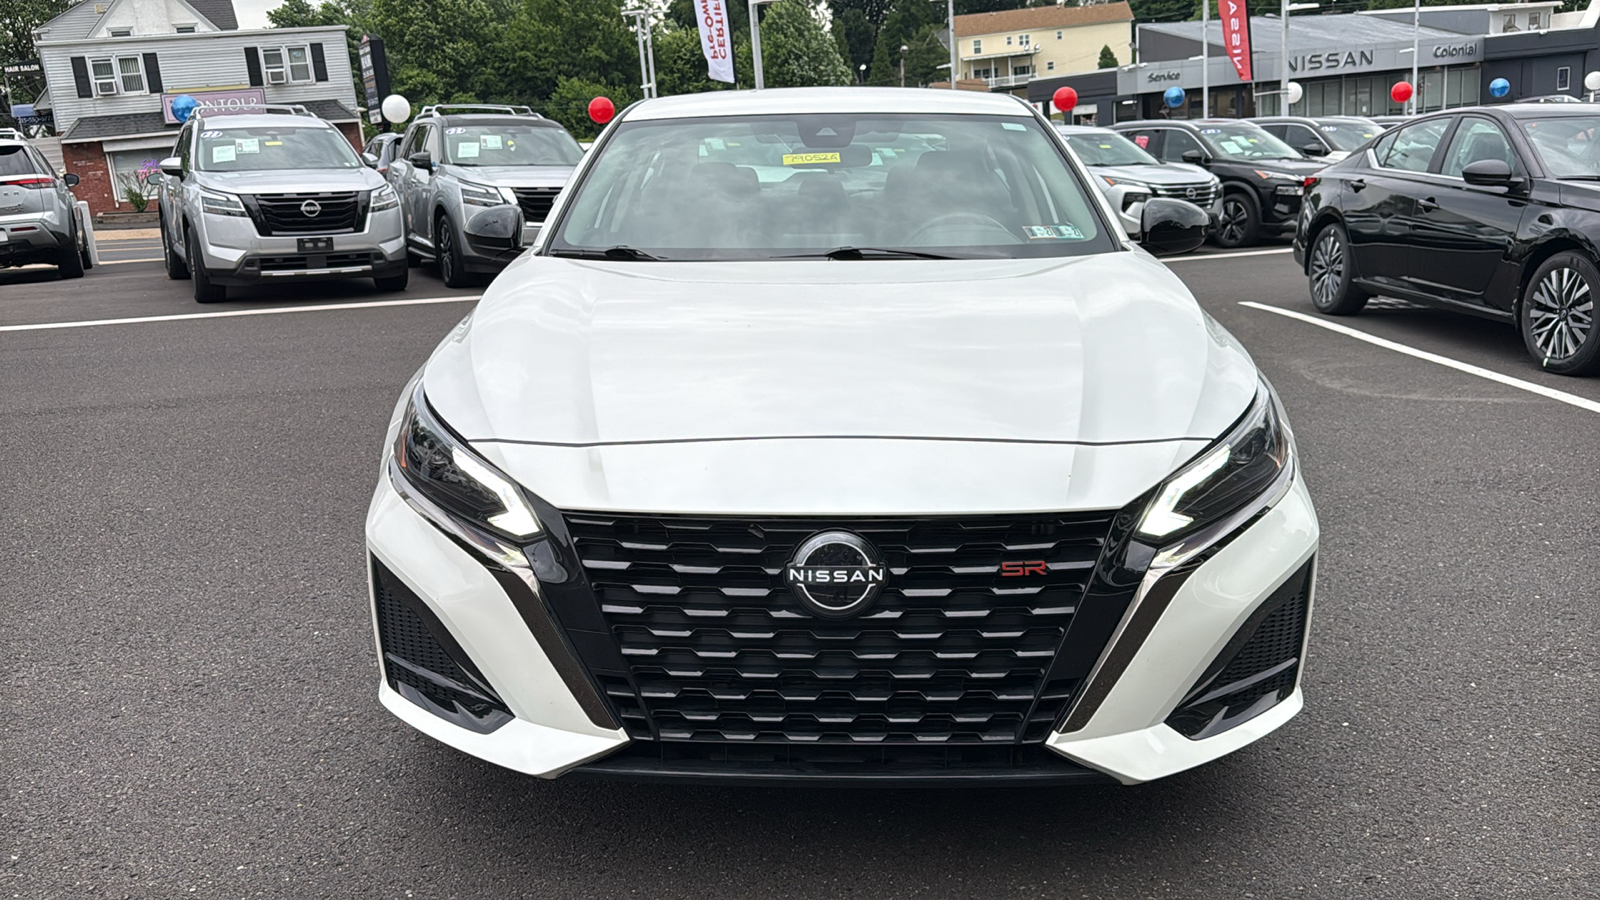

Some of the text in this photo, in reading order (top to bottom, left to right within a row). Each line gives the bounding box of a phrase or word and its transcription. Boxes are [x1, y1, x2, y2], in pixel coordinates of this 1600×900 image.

[1433, 42, 1477, 58] Colonial
[20, 64, 40, 72] SALON
[1288, 50, 1373, 72] NISSAN
[1147, 70, 1181, 83] Service
[789, 568, 884, 583] NISSAN
[1001, 561, 1047, 576] SR
